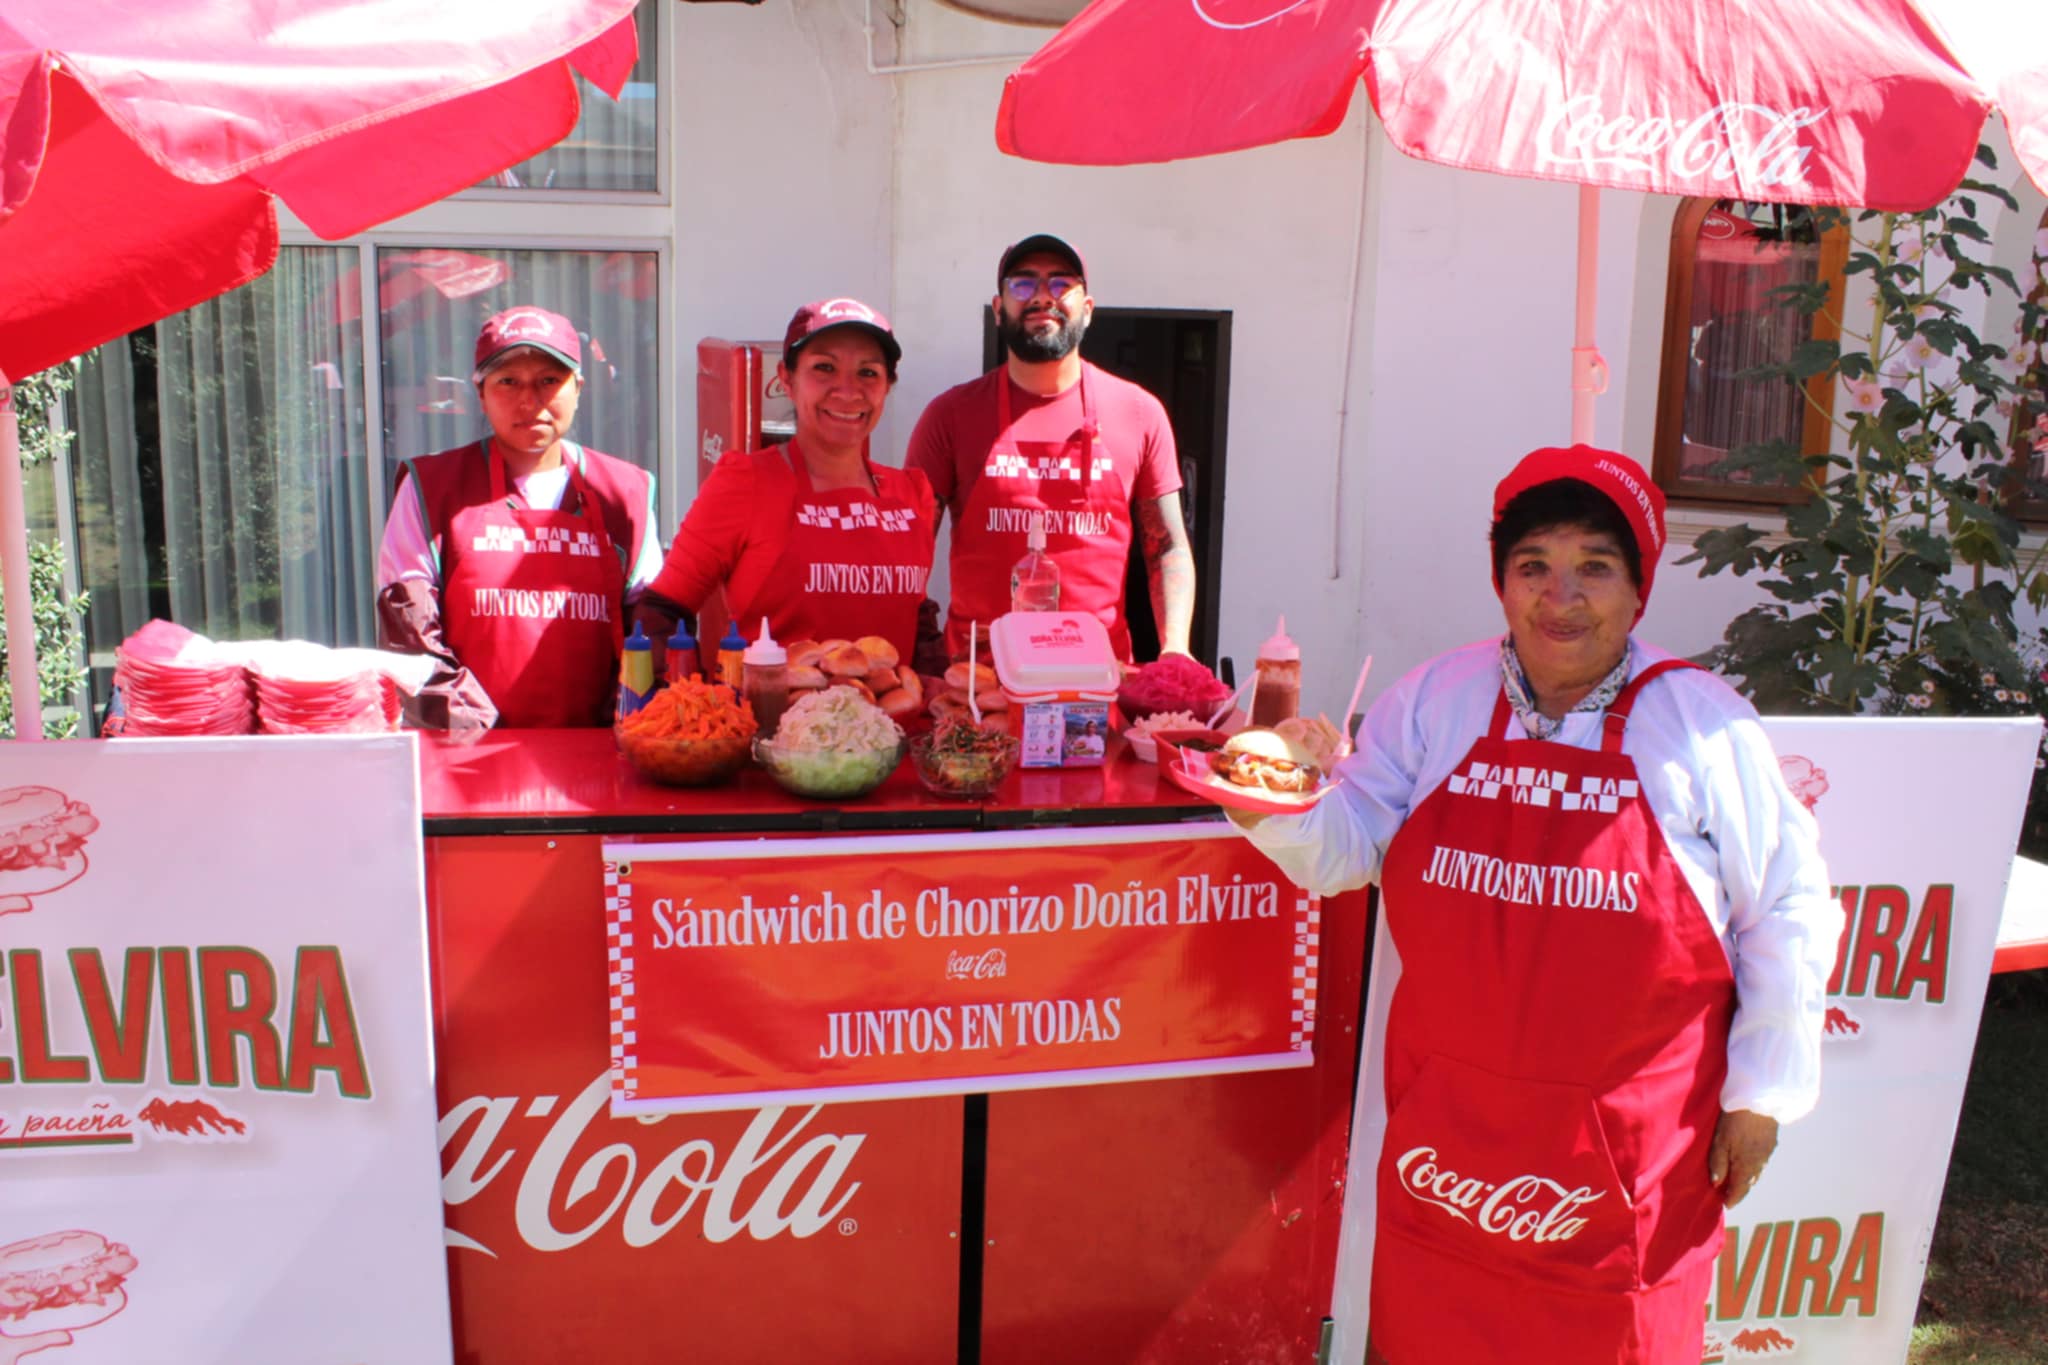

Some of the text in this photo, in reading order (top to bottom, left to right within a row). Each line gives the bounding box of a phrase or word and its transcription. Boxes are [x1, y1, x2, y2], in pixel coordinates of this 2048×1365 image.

[1536, 94, 1832, 187] Coca-Cola
[1594, 459, 1640, 495] JUNTOS
[1637, 488, 1650, 511] EN
[985, 508, 1113, 536] JUNTO EN TODAS
[471, 588, 539, 618] JUNTOS
[543, 590, 566, 619] EN
[804, 563, 870, 594] JUNTOS
[872, 565, 894, 594] EN
[1422, 845, 1639, 913] JUNTOS EN TODAS
[652, 874, 1279, 949] Sándwich de Chorizo Doña Elvira
[0, 945, 372, 1100] LVIRA
[819, 997, 1121, 1059] JUNTOS EN TODAS
[18, 1103, 132, 1148] paceña
[1396, 1146, 1607, 1243] Coca-Cola
